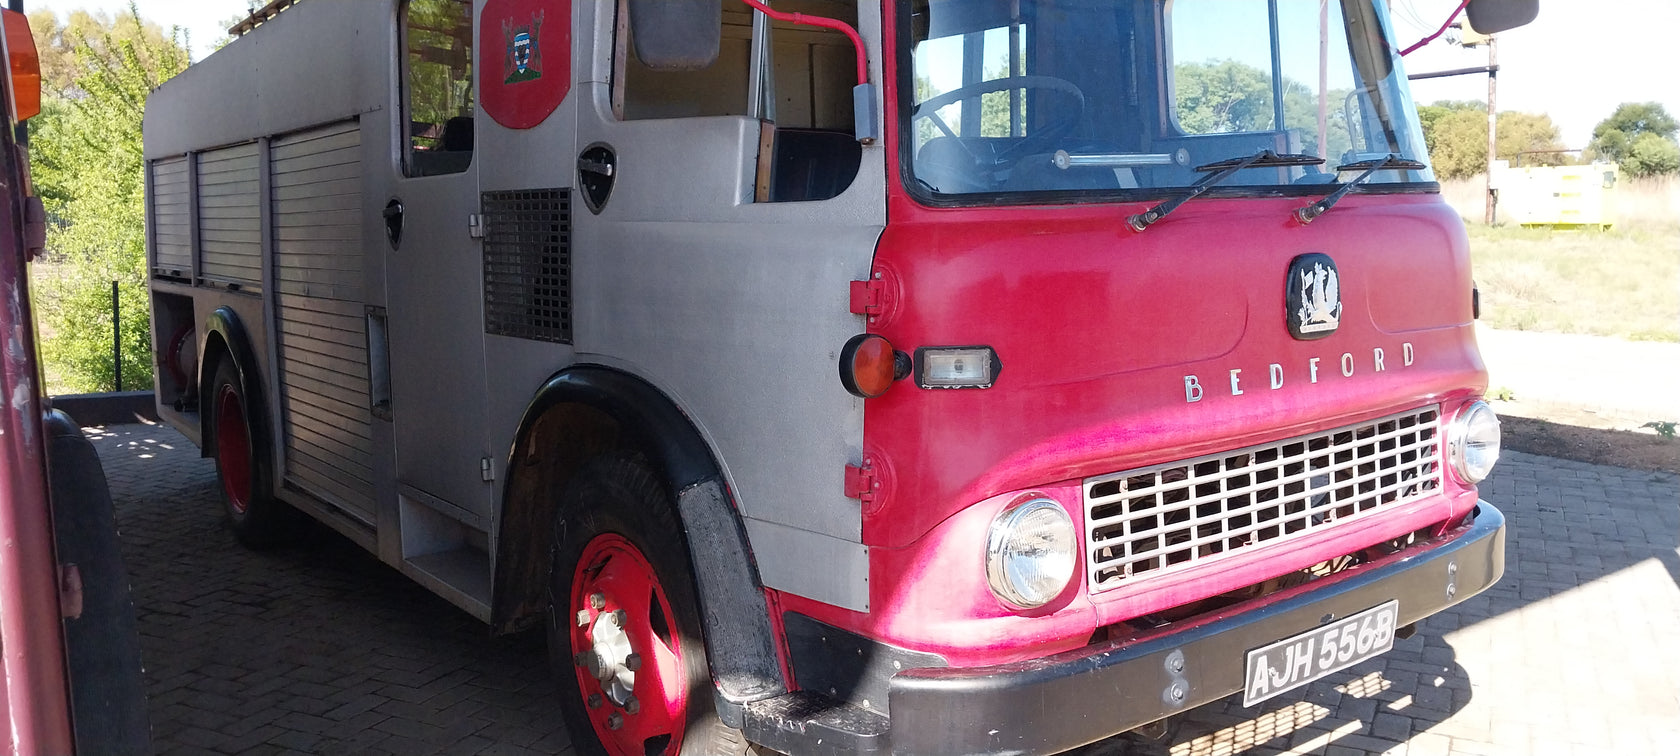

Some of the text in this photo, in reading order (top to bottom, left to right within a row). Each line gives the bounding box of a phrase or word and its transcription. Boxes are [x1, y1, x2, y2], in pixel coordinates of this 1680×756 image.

[1184, 343, 1414, 402] BEDFORD
[1250, 609, 1393, 699] AJH 556B
